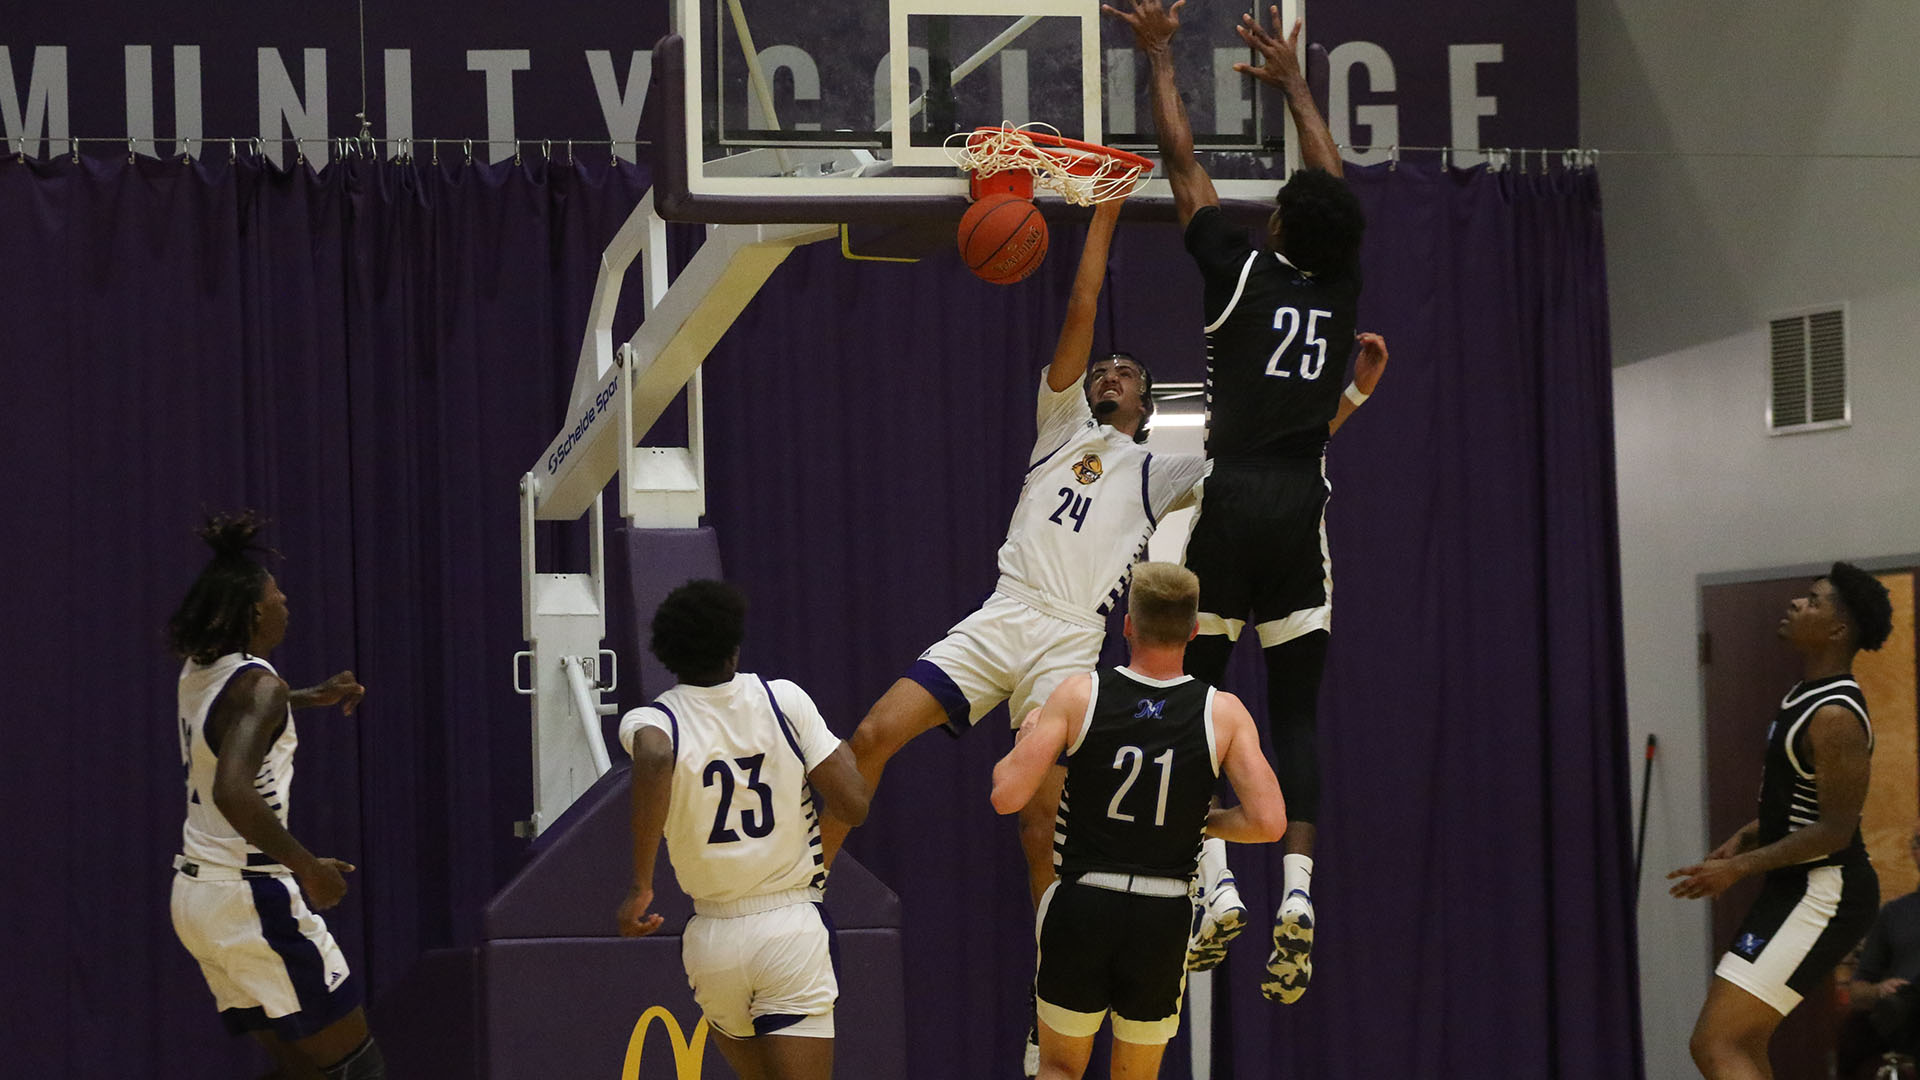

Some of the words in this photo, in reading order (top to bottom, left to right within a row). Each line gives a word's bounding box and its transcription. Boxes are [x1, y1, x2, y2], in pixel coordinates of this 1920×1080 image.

[1265, 306, 1332, 380] 25
[557, 407, 596, 465] Schelde
[1048, 487, 1092, 533] 24
[703, 753, 775, 844] 23
[1107, 745, 1174, 826] 21
